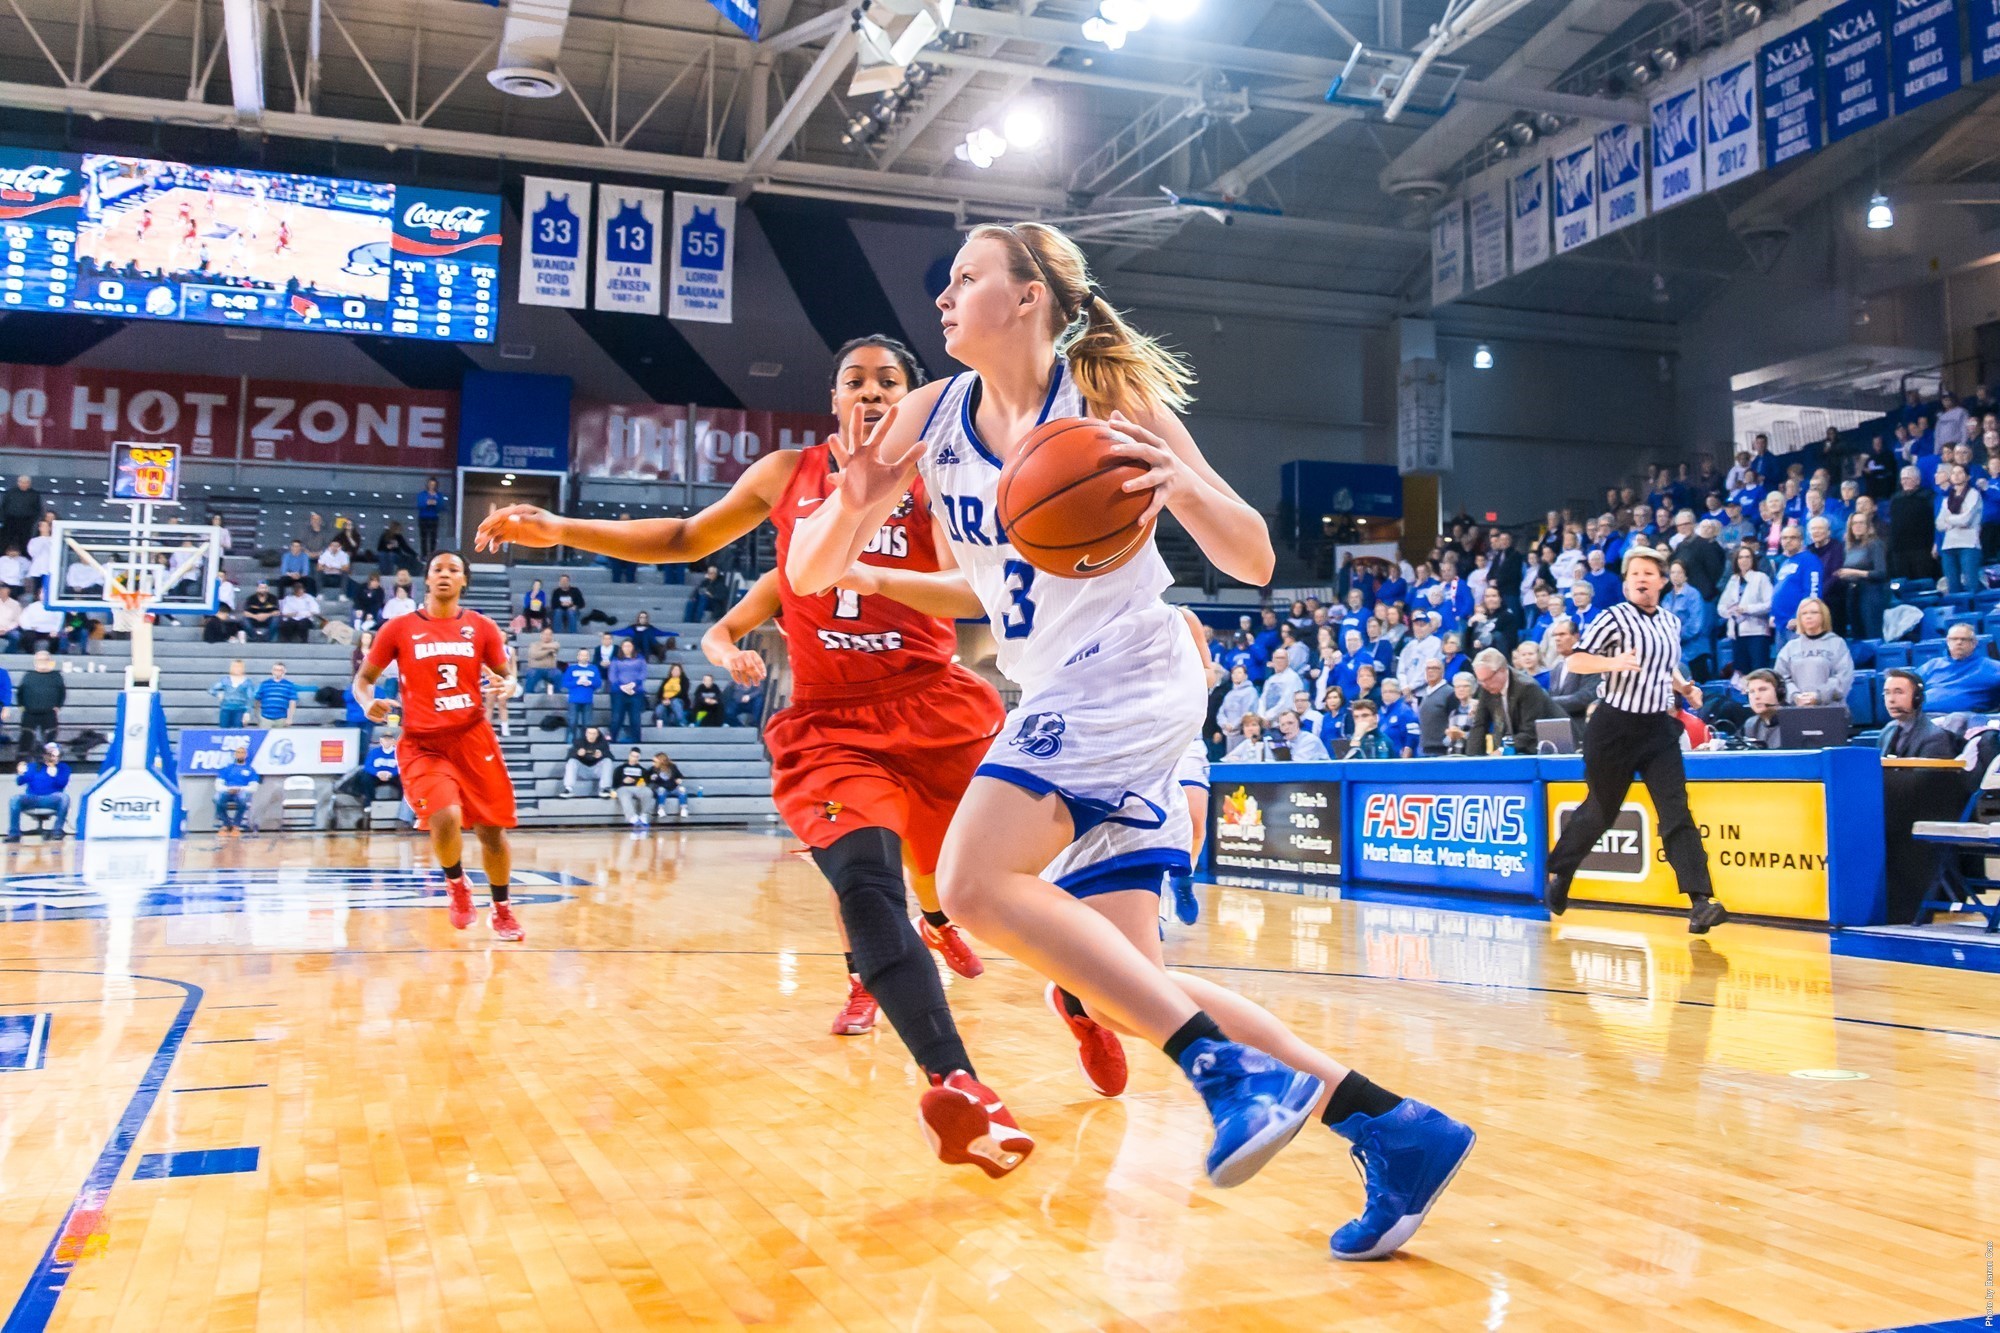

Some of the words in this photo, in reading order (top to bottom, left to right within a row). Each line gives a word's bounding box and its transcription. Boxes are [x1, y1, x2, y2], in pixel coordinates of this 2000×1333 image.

[1828, 9, 1876, 47] NCAA
[1767, 36, 1811, 72] NCAA
[1718, 143, 1747, 176] 2012
[403, 202, 490, 233] Coca-Cola
[540, 218, 572, 244] 33
[616, 225, 646, 251] 13
[9, 237, 27, 249] 0
[52, 240, 70, 253] 0
[688, 231, 719, 257] 55
[8, 250, 26, 263] 0
[51, 254, 68, 267] 0
[532, 258, 575, 271] WANDA
[7, 264, 25, 277] 0
[50, 267, 68, 280] 0
[537, 272, 569, 285] FORD
[617, 266, 641, 277] JAN
[686, 271, 717, 284] LORRI
[5, 278, 24, 290] 0
[49, 281, 66, 294] 0
[439, 274, 453, 286] 0
[476, 277, 490, 289] 0
[607, 279, 650, 291] JENSEN
[98, 281, 123, 300] 0
[438, 286, 452, 298] 0
[476, 289, 490, 301] 0
[677, 285, 725, 299] BAUMAN
[4, 292, 22, 304] 0
[48, 295, 65, 307] 0
[437, 299, 452, 311] 0
[475, 302, 489, 314] 0
[342, 300, 366, 318] 0
[436, 312, 451, 324] 0
[474, 315, 488, 326] 0
[436, 325, 450, 336] 0
[473, 328, 488, 339] 0
[70, 386, 227, 434] HOT
[251, 397, 446, 449] ZONE
[936, 457, 960, 465] adidas
[1002, 558, 1035, 640] 3
[817, 629, 903, 652] STATE
[414, 642, 474, 659] ILLINOIS
[437, 664, 458, 690] 3
[100, 798, 160, 812] Smart
[1720, 825, 1740, 840] IN
[1591, 829, 1639, 854] EITZ
[1363, 843, 1388, 861] More
[1389, 843, 1412, 863] than
[1413, 844, 1436, 865] fast.
[1437, 847, 1465, 867] More
[1466, 848, 1492, 869] than
[1720, 850, 1828, 871] COMPANY
